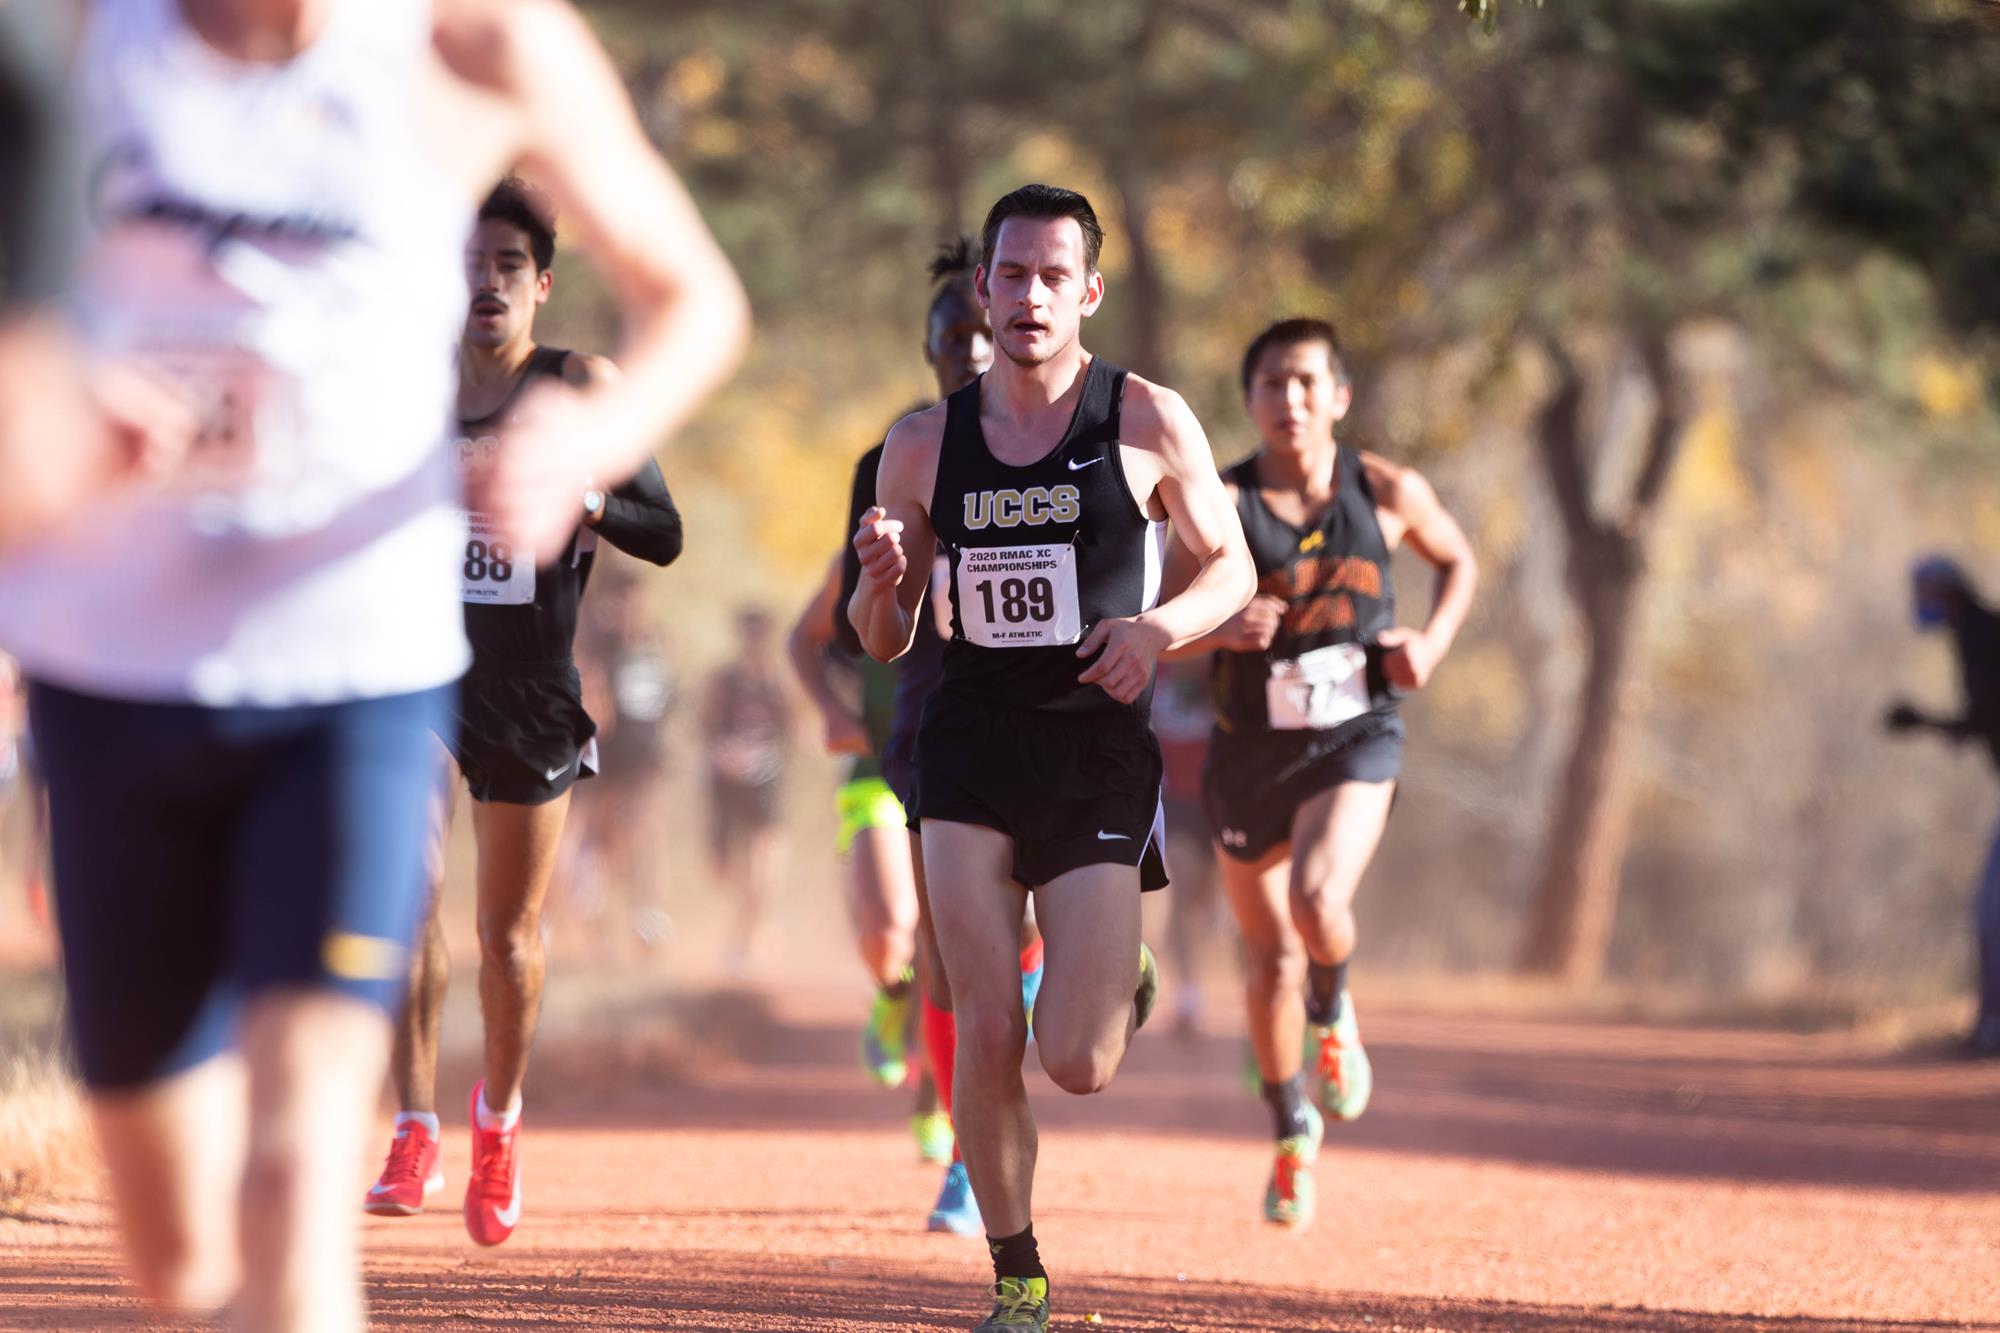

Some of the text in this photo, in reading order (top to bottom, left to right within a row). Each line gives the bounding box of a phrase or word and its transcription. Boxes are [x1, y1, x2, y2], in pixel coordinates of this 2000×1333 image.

[963, 484, 1080, 531] UCCS
[464, 540, 512, 582] 88
[966, 560, 1058, 573] CHAMPIONSHIPS
[970, 549, 1052, 562] 2020 RMAC XC
[976, 577, 1055, 624] 189
[1008, 630, 1043, 638] ATHLETIC
